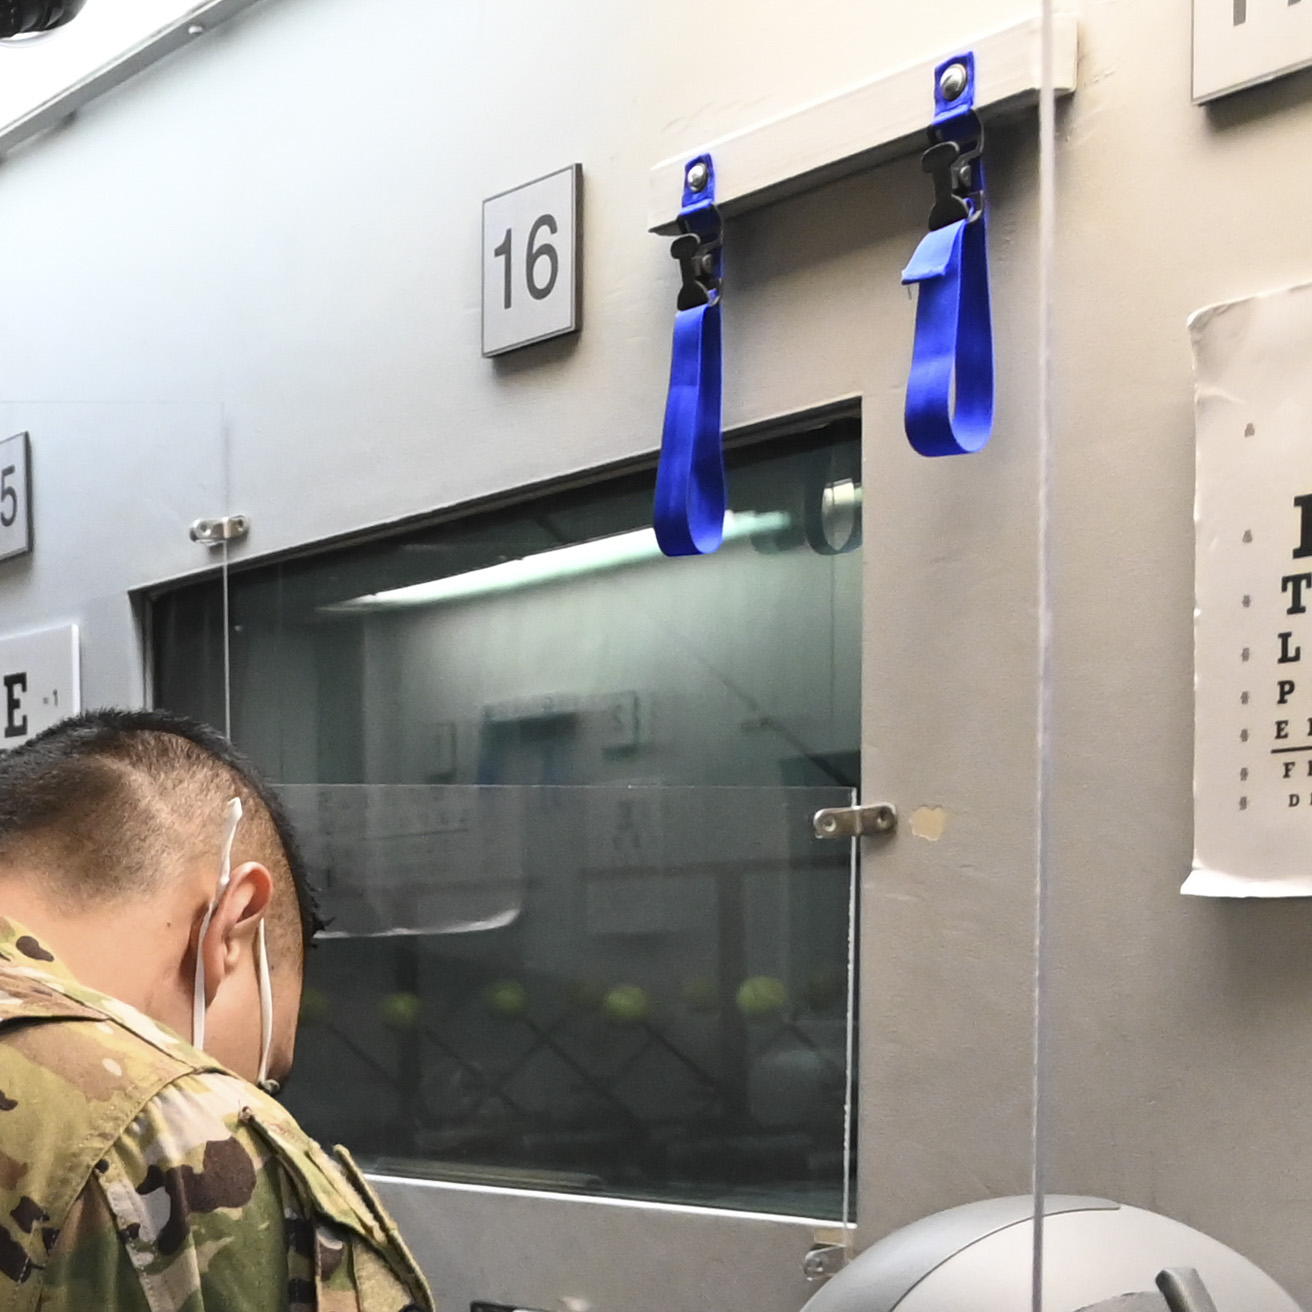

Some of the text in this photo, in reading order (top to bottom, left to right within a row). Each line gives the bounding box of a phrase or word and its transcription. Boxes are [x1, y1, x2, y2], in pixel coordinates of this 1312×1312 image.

[493, 213, 560, 311] 16
[1277, 631, 1301, 664] L
[4, 672, 28, 738] E
[1277, 680, 1295, 704] P
